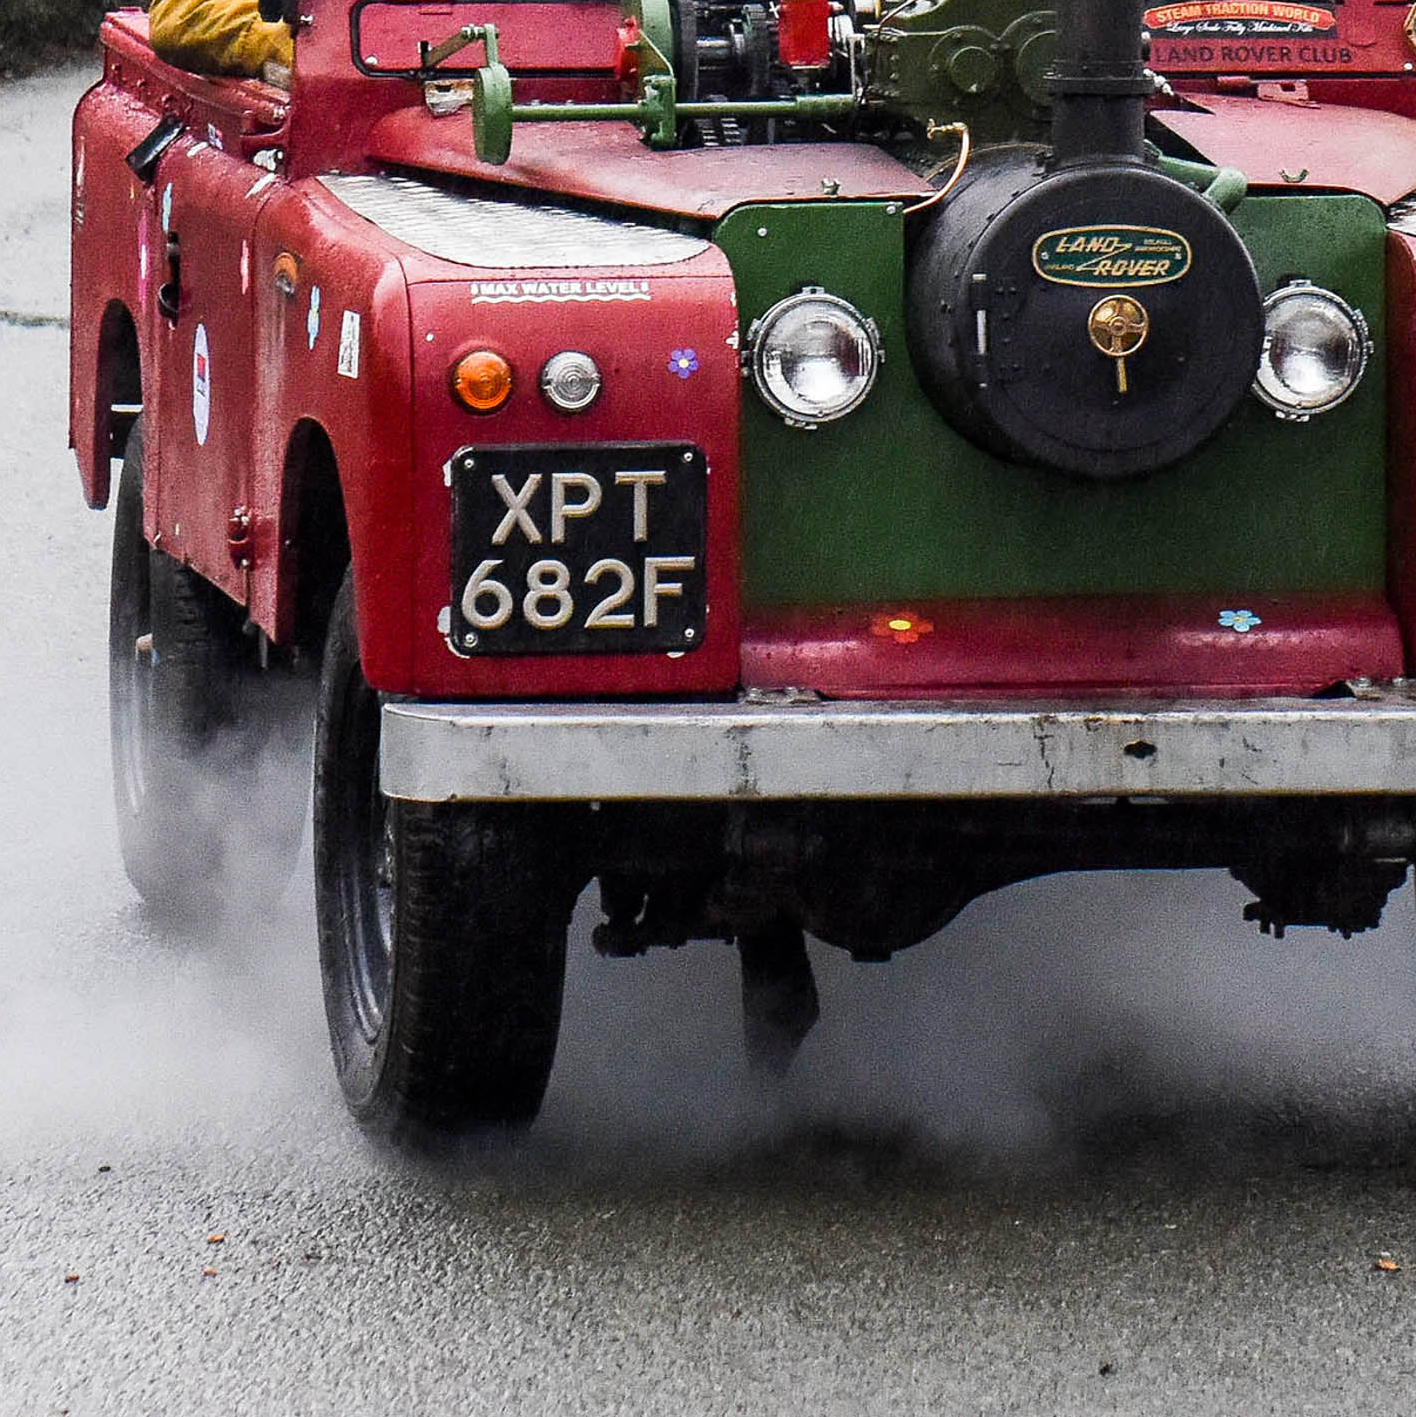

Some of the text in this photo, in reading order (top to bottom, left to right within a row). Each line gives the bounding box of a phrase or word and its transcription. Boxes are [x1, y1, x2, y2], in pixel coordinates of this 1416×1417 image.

[1156, 2, 1319, 23] STEAM TRACTION WORLD
[1155, 46, 1352, 63] LAND ROVER CLUB
[1055, 236, 1121, 253] LAND
[1093, 259, 1171, 276] ROVER
[480, 282, 640, 295] MAX WATER LEVEL
[491, 470, 667, 545] XPT
[461, 556, 695, 631] 682F
